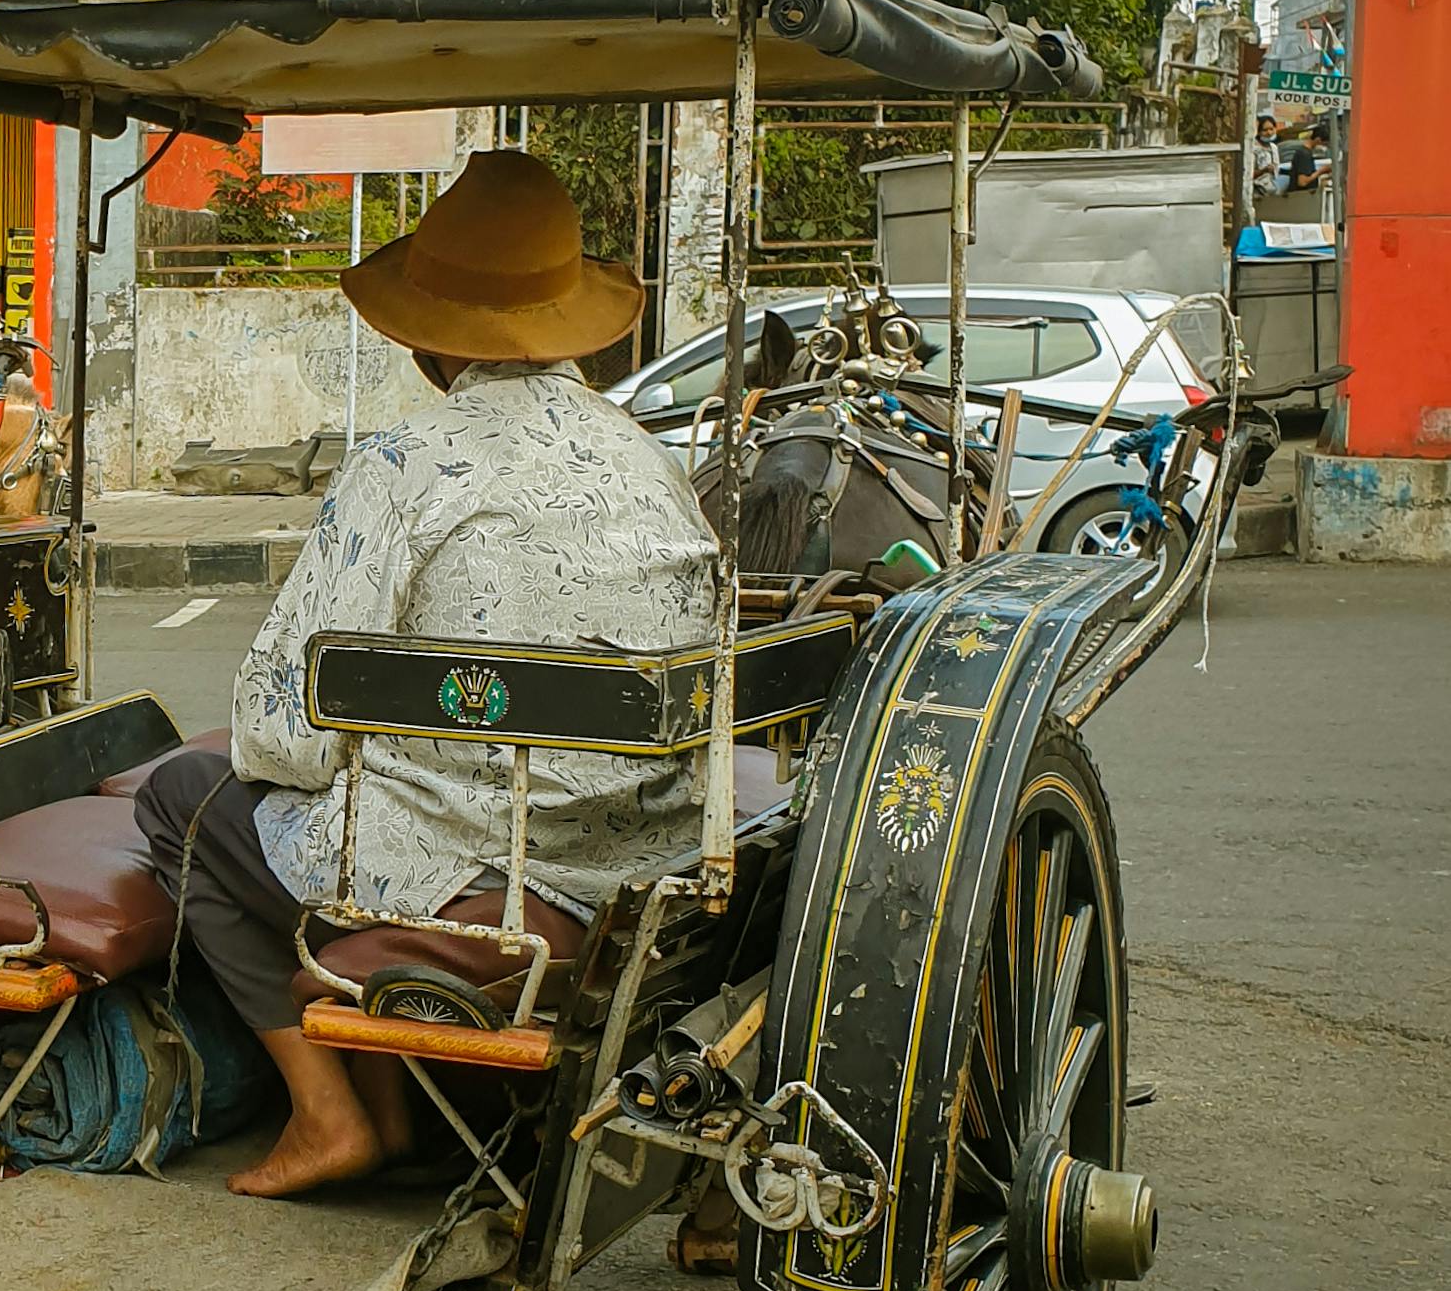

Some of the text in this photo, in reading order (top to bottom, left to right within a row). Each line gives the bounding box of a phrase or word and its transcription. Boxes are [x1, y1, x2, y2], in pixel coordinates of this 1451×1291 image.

[1280, 73, 1308, 90] JL.
[1275, 92, 1310, 104] KODE
[1313, 95, 1341, 107] POS
